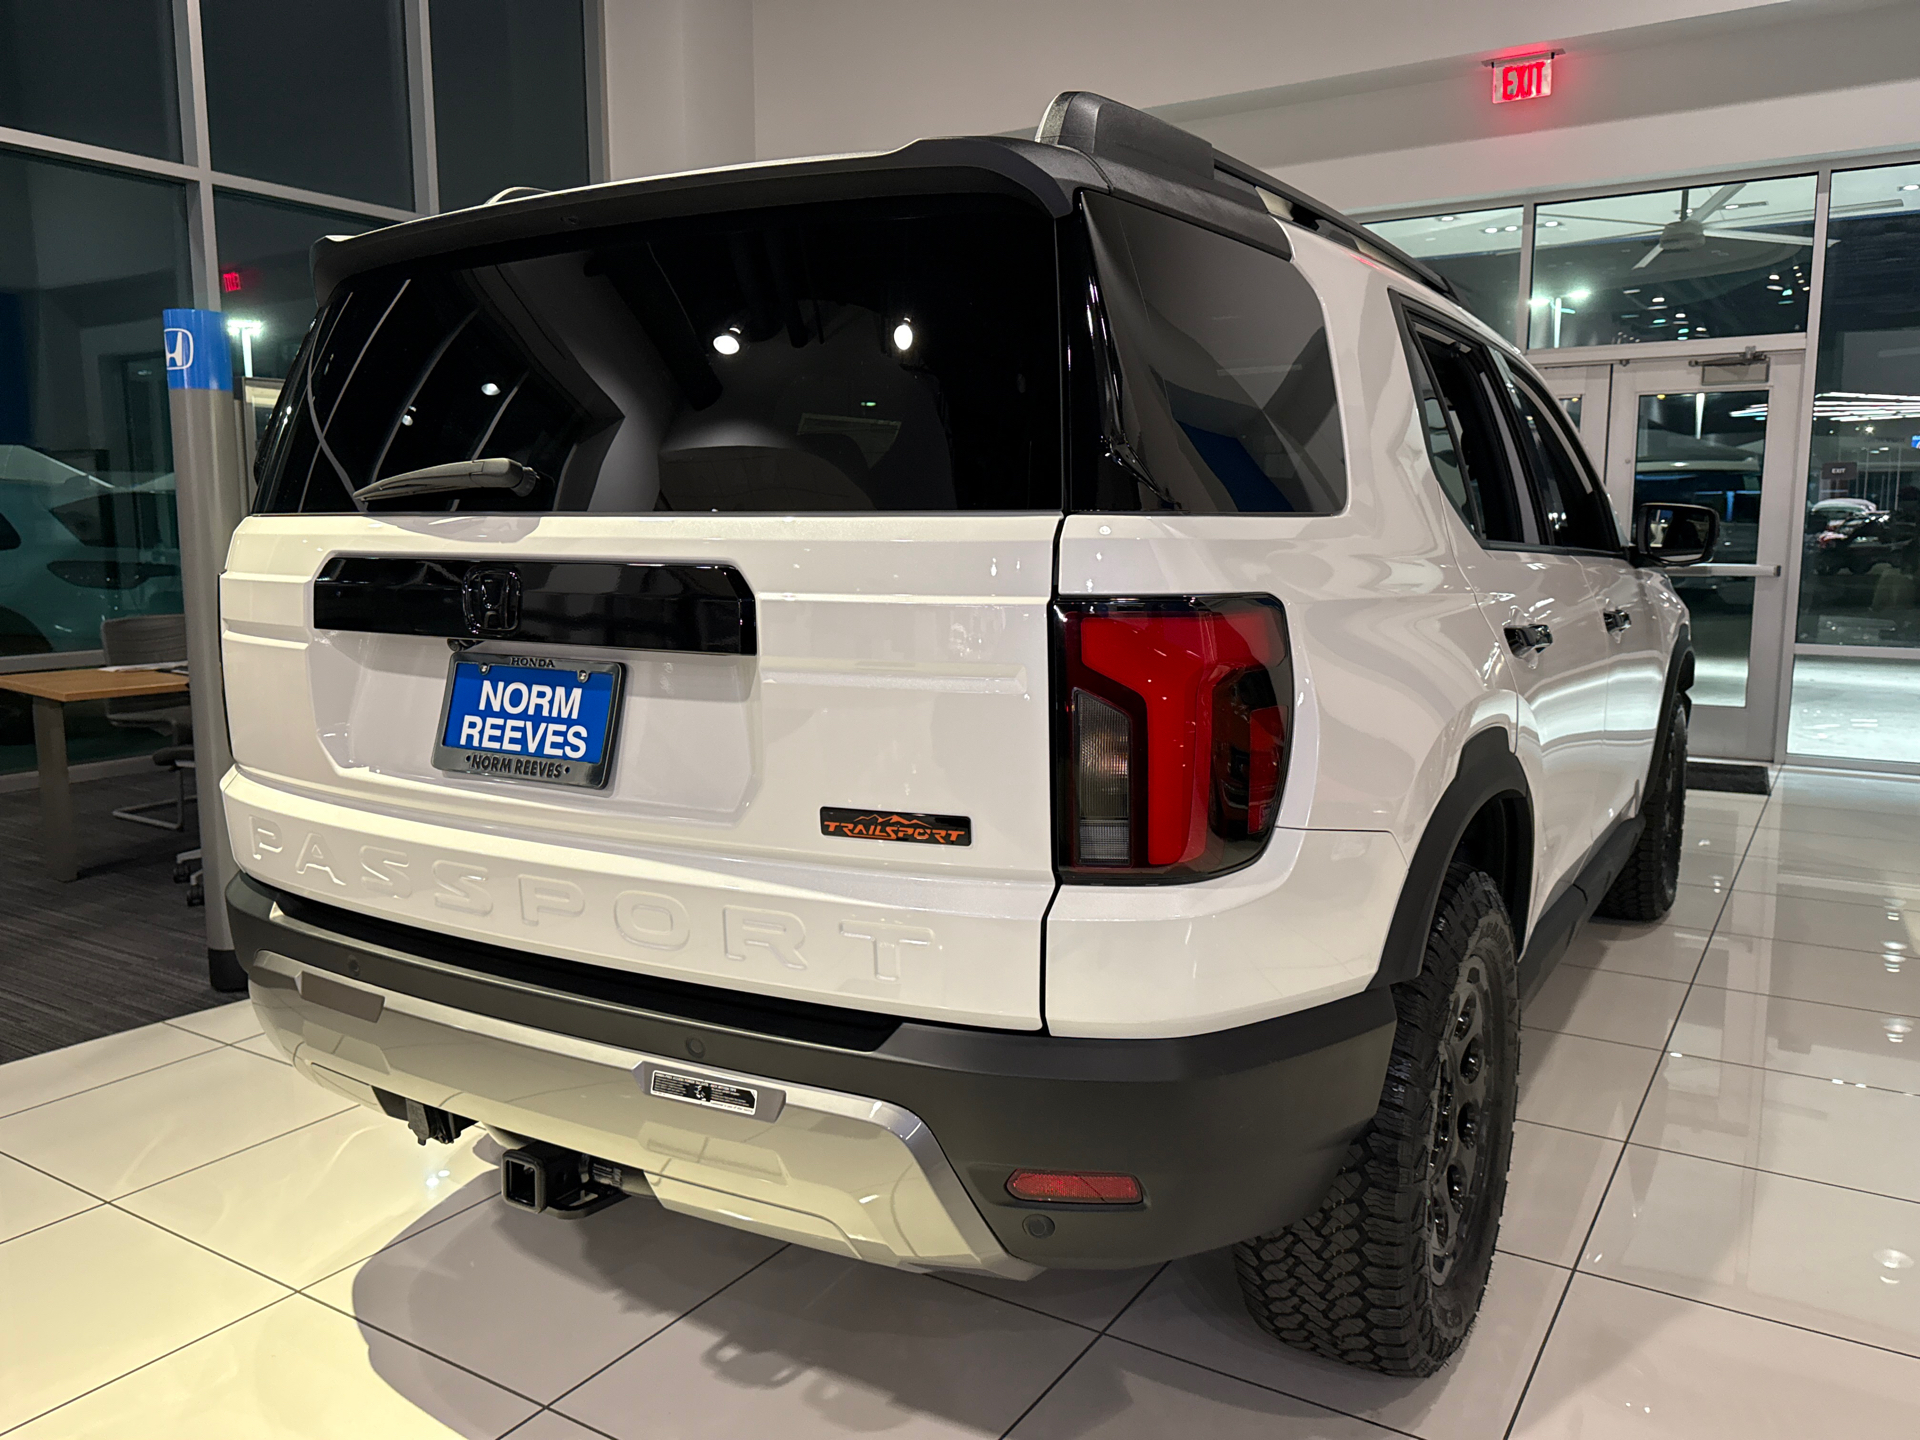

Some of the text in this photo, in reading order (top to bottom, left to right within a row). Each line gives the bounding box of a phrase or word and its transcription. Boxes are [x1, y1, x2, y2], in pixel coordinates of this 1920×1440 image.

[1502, 61, 1546, 101] EXIT
[510, 656, 556, 668] HONDA
[478, 680, 582, 720] NORM
[459, 714, 588, 759] REEVES
[471, 754, 563, 779] NORM REEVES
[823, 821, 966, 844] TRAILSPORT
[248, 814, 935, 982] PASSPORT
